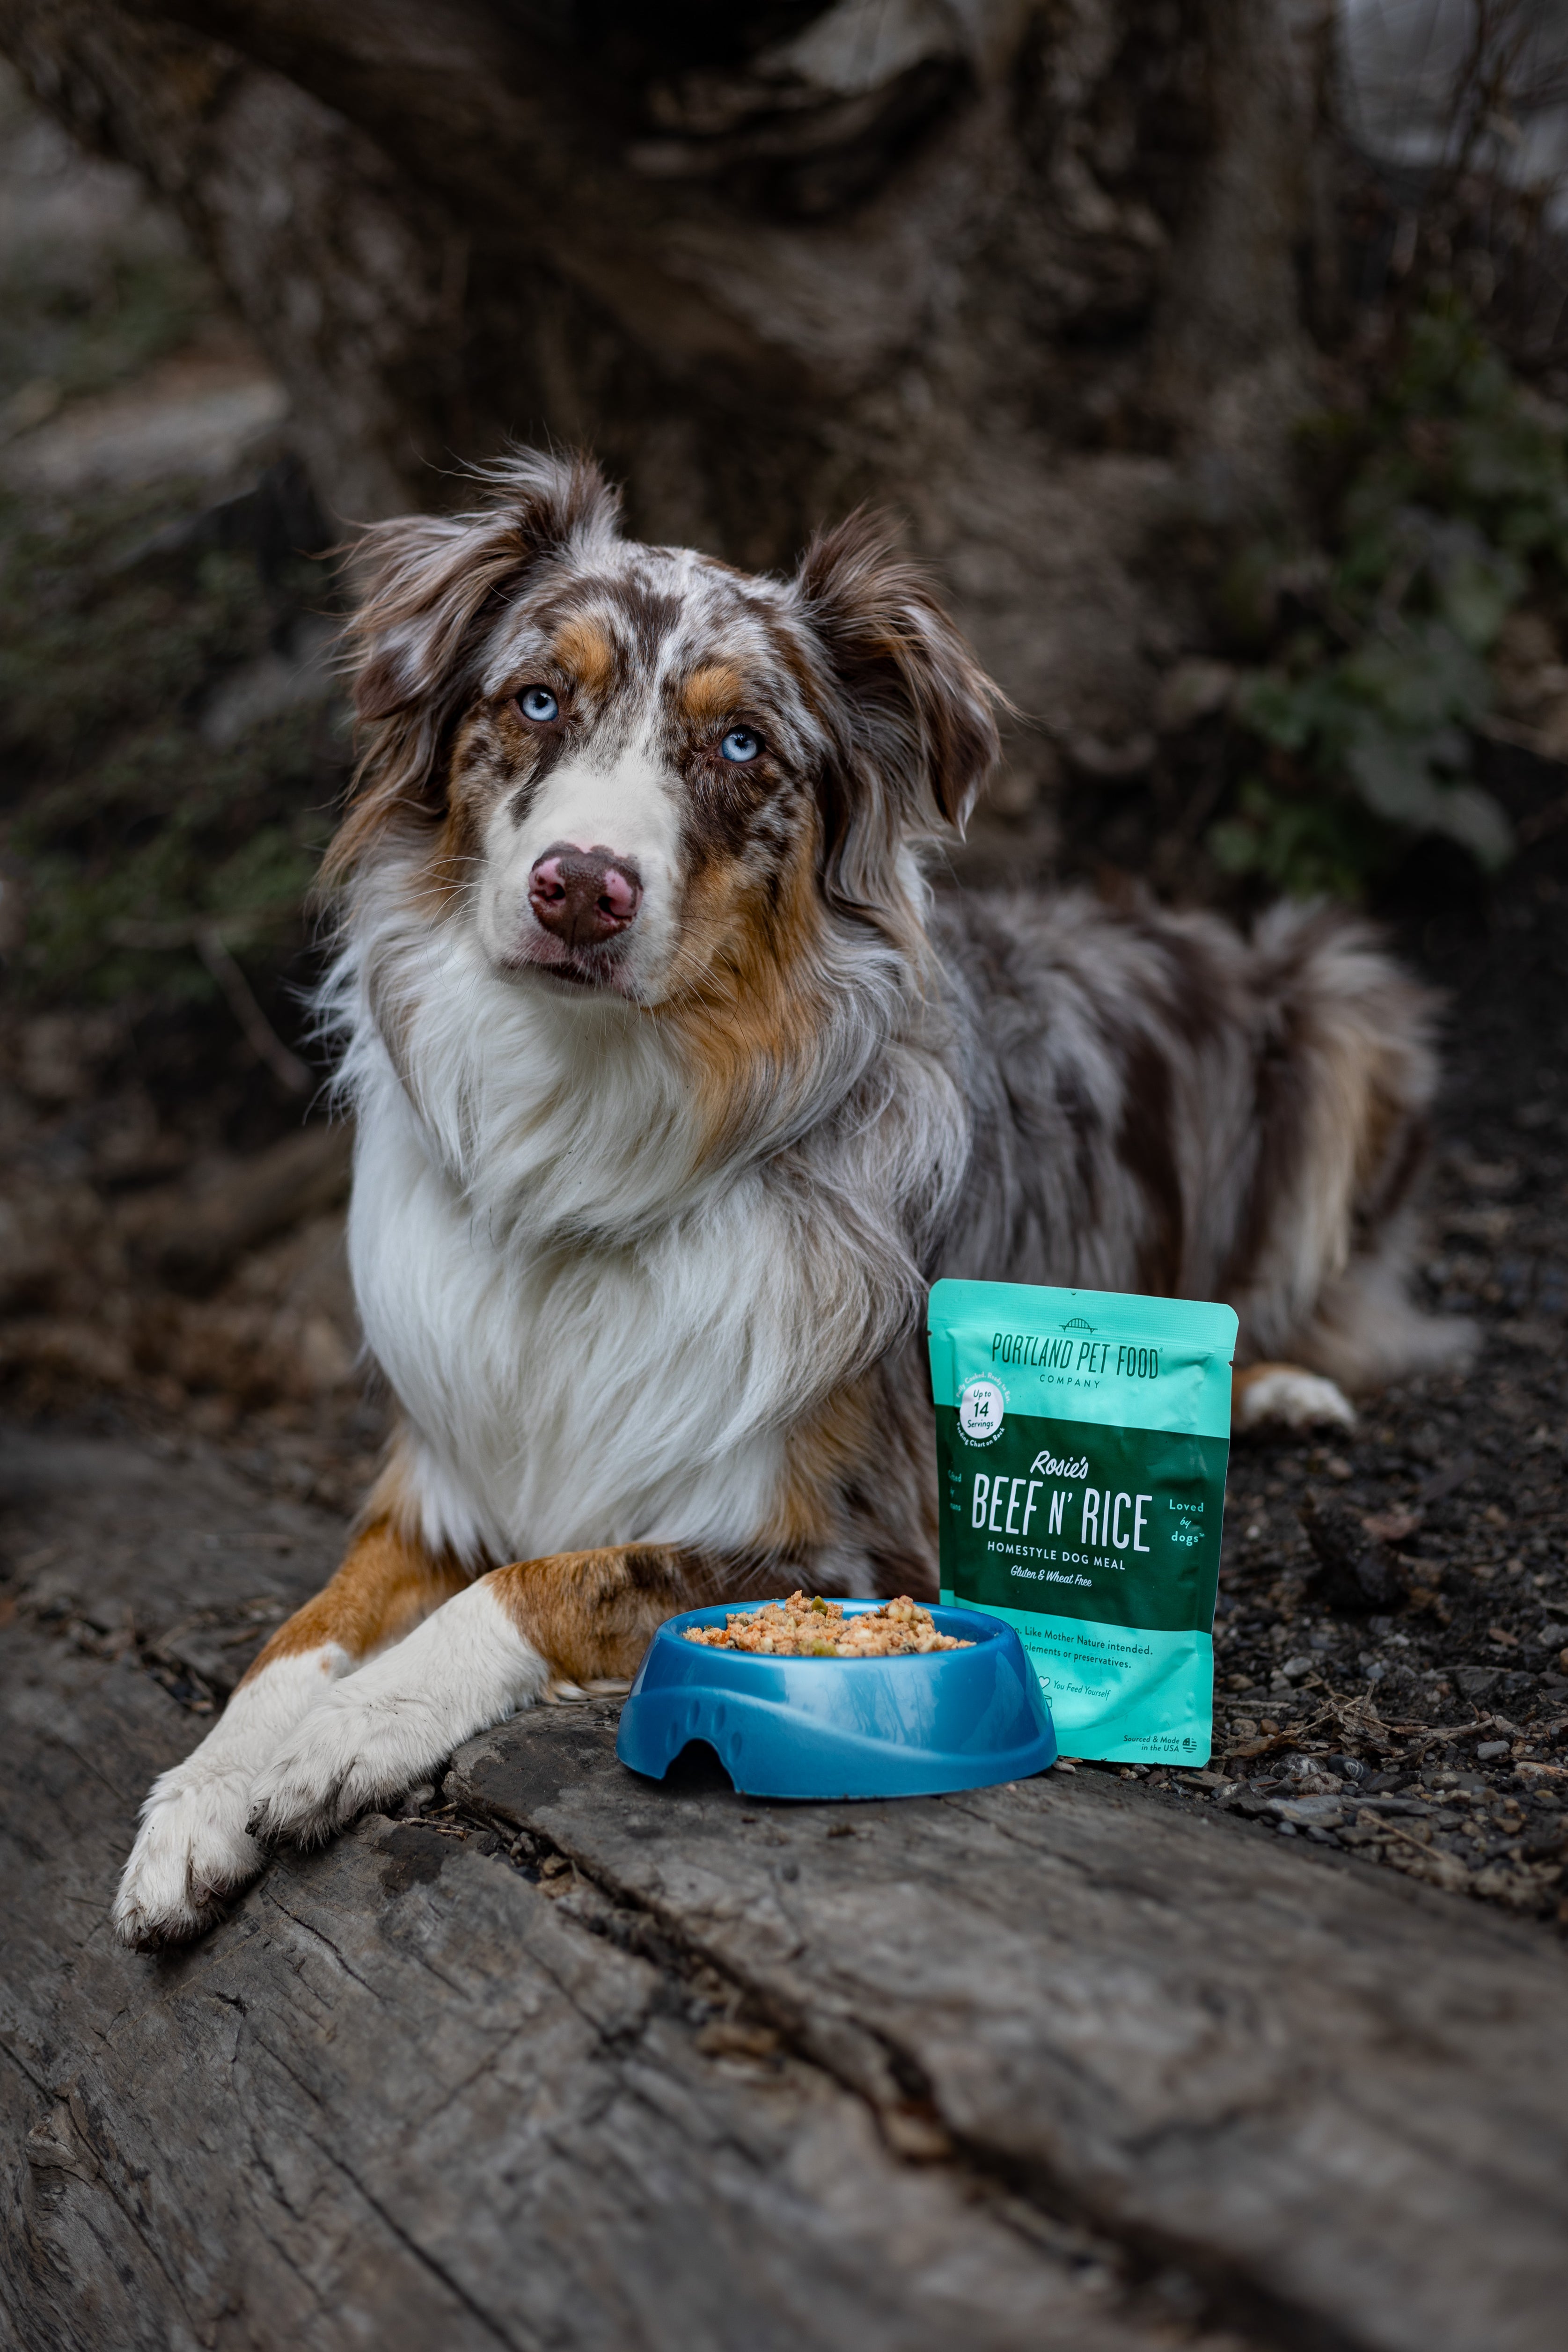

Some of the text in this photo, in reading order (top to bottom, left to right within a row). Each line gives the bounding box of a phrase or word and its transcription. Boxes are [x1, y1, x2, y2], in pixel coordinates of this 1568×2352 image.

[992, 1333, 1073, 1369] PORTLAND
[1077, 1342, 1110, 1373] PET
[988, 1372, 1002, 1385] Ready
[1040, 1374, 1100, 1389] COMPANY
[973, 1390, 983, 1400] Up
[974, 1401, 989, 1417] 14
[956, 1421, 968, 1445] Feeding
[992, 1427, 1005, 1441] Back
[967, 1419, 994, 1429] Servings
[1030, 1450, 1089, 1479] Rosie's
[972, 1473, 1043, 1535] BEEF
[1081, 1487, 1152, 1552] RICE
[1169, 1499, 1204, 1512] Loved
[1180, 1516, 1192, 1528] by
[987, 1541, 1125, 1570] HOMESTYLE DOG MEAL
[1011, 1565, 1092, 1587] Gluten & Wheat Free
[1025, 1626, 1042, 1638] Like
[1045, 1630, 1074, 1643] Mother
[1077, 1635, 1105, 1649] Nature
[1107, 1641, 1153, 1656] intended.
[1024, 1642, 1061, 1656] plements
[1074, 1653, 1131, 1669] preservatives.
[1053, 1680, 1111, 1701] You Feed Yourself
